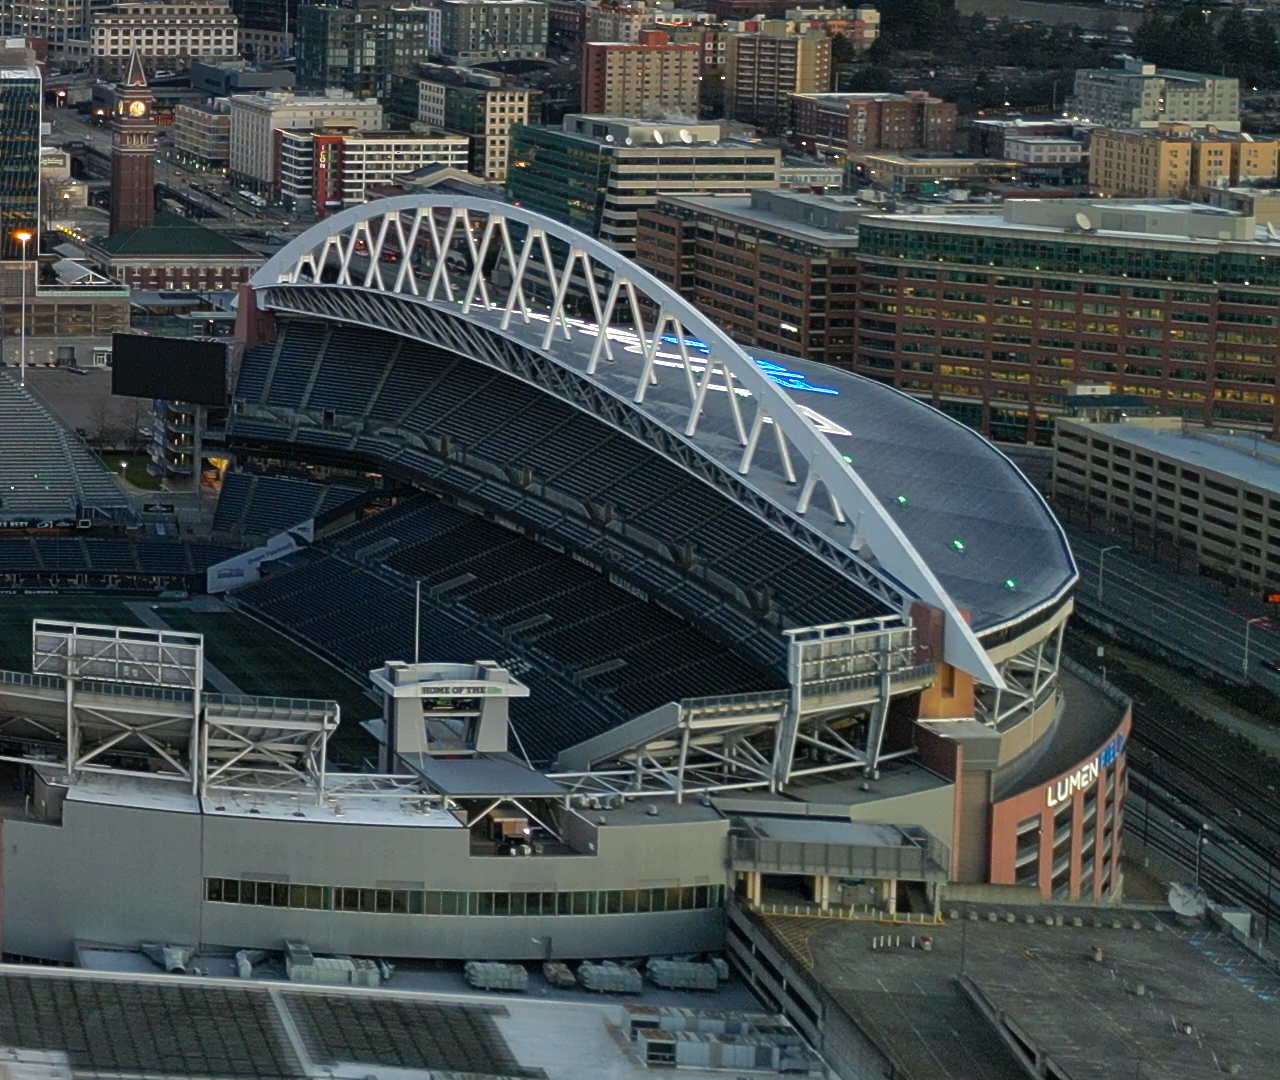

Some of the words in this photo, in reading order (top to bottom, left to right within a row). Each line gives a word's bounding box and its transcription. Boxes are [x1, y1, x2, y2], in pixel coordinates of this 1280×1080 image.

[421, 686, 451, 695] HOME
[451, 686, 464, 695] OF
[1047, 757, 1099, 807] LUMEN
